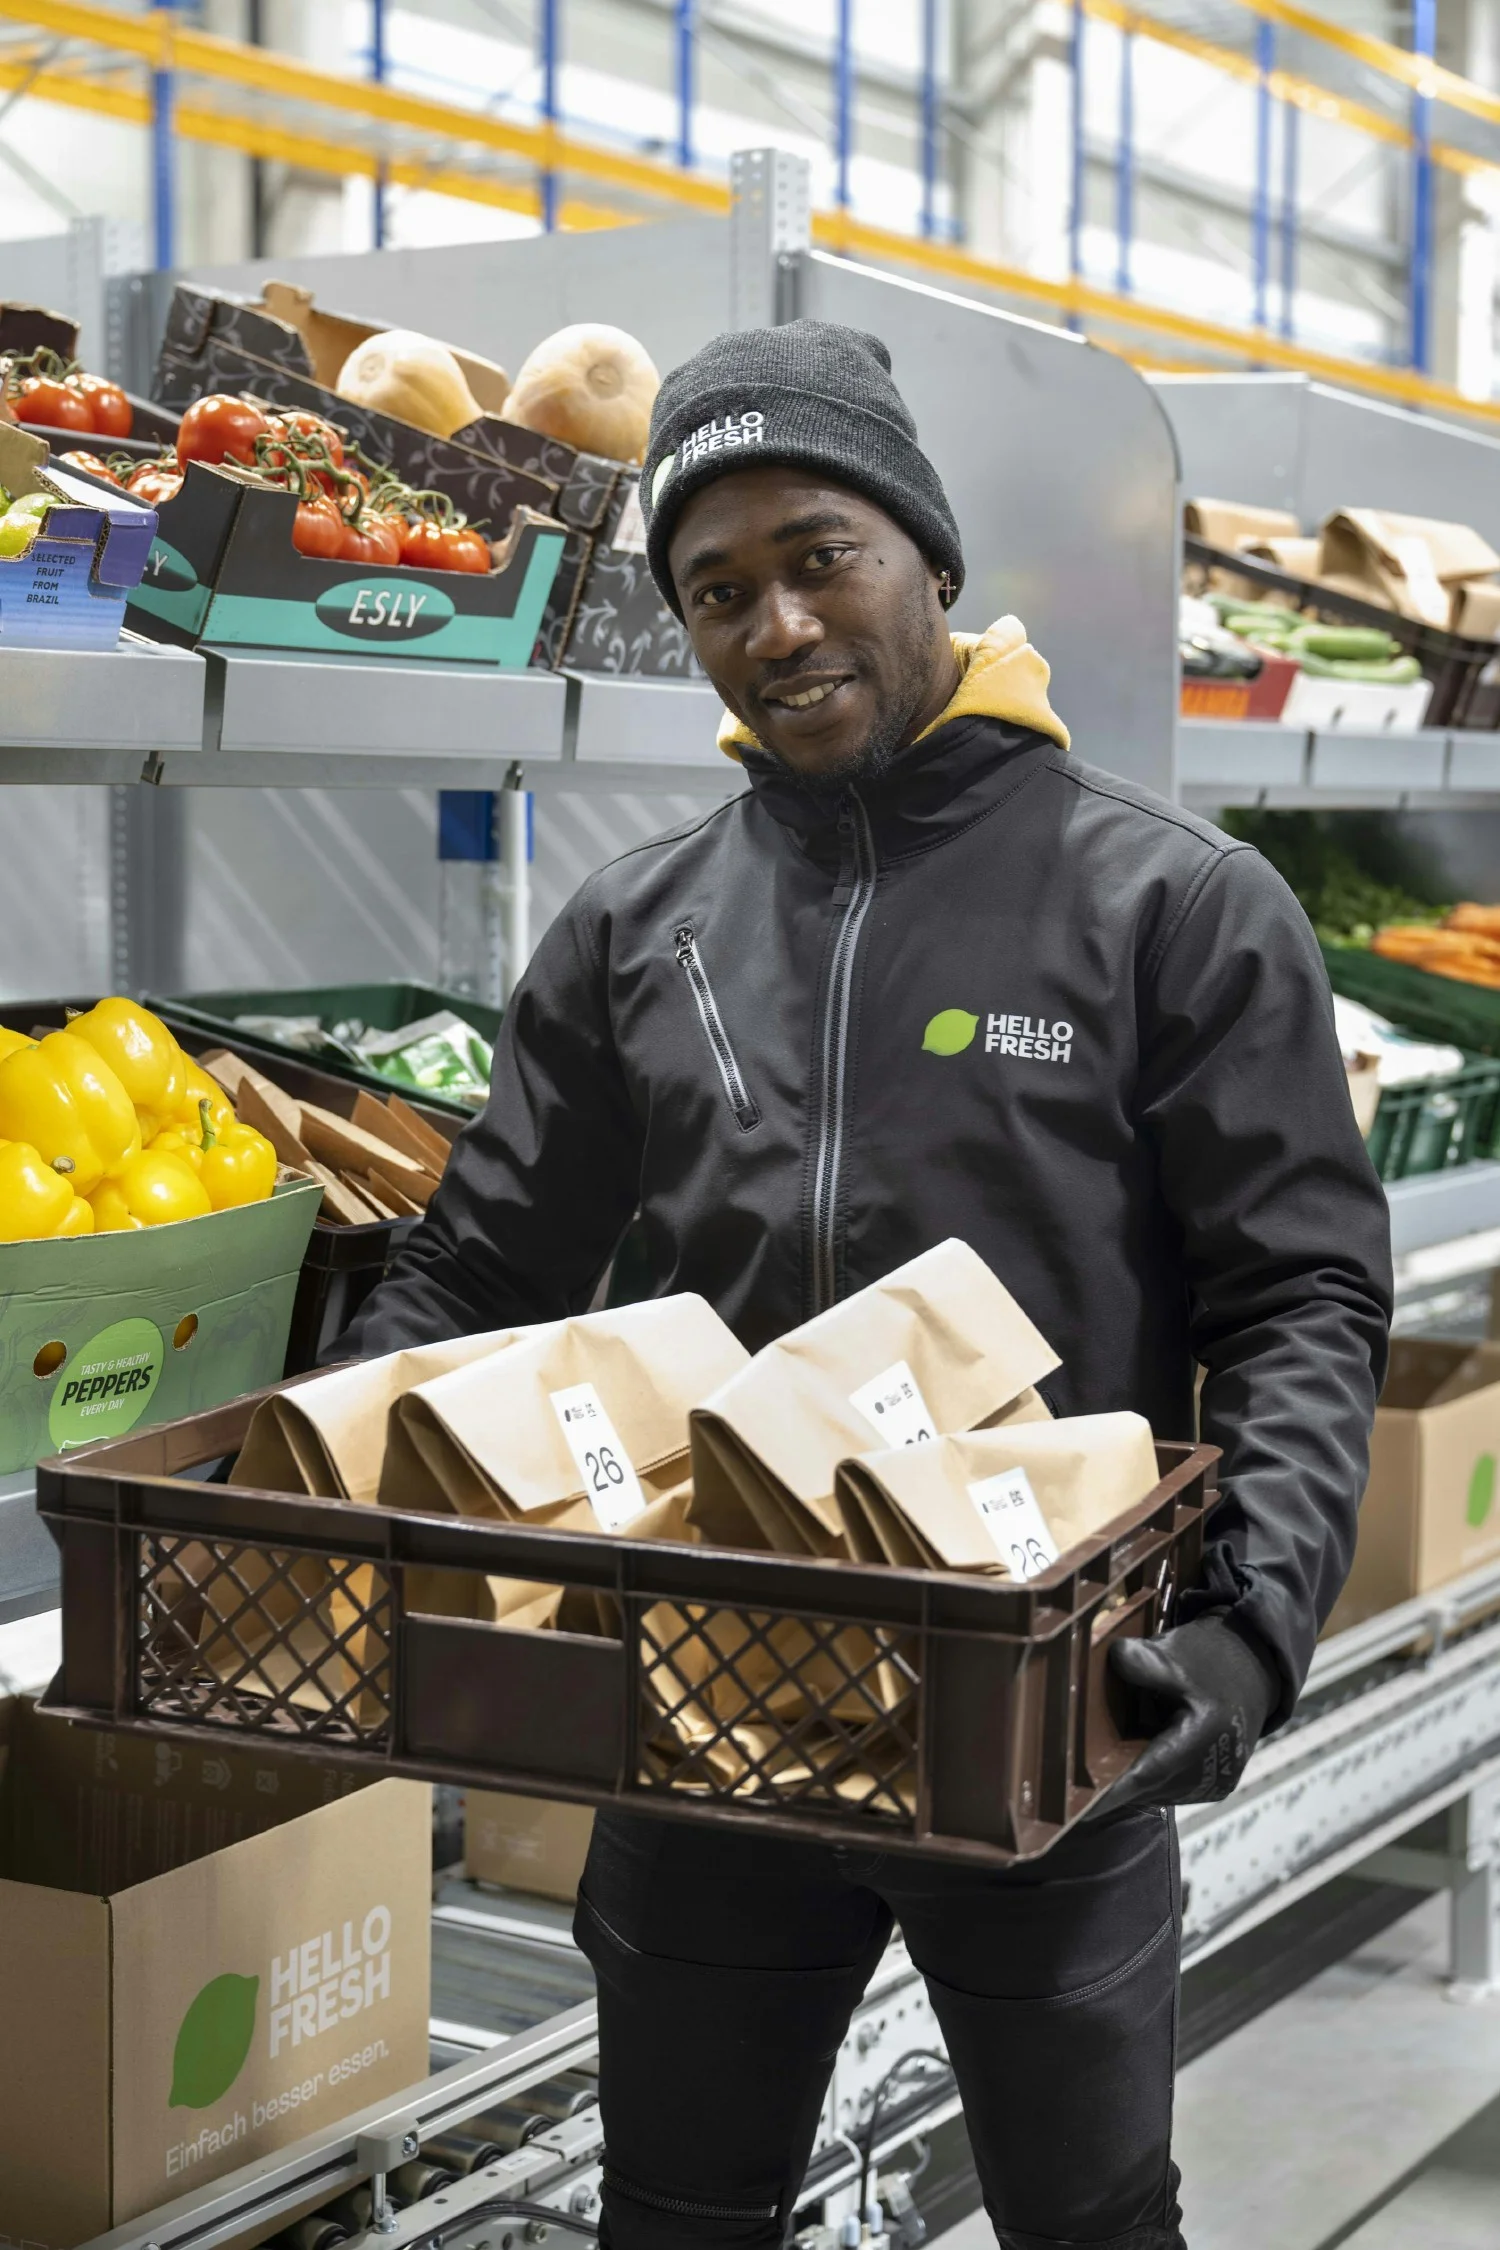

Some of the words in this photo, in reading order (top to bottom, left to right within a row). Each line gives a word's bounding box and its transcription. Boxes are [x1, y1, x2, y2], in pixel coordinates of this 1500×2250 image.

[682, 411, 764, 456] HELLO
[682, 426, 763, 468] FRESH
[31, 553, 76, 565] SELECTED
[36, 567, 65, 577] FRUIT
[26, 594, 60, 605] BRAZIL
[32, 581, 59, 591] FROM
[348, 589, 427, 628] ESLY
[986, 1013, 1074, 1042] HELLO
[984, 1033, 1072, 1063] FRESH
[81, 1361, 107, 1376] TASTY
[107, 1359, 115, 1371] &
[116, 1352, 151, 1369] HEALTHY
[61, 1365, 154, 1407] PEPPERS
[80, 1401, 108, 1417] EVERY
[107, 1398, 125, 1411] DAY
[585, 1446, 625, 1492] 26
[1010, 1537, 1051, 1578] 26
[270, 1904, 392, 2007] HELLO
[269, 1950, 391, 2059] FRESH
[165, 2111, 247, 2179] Einfach
[251, 2071, 324, 2130] besser
[328, 2039, 390, 2086] essen.
